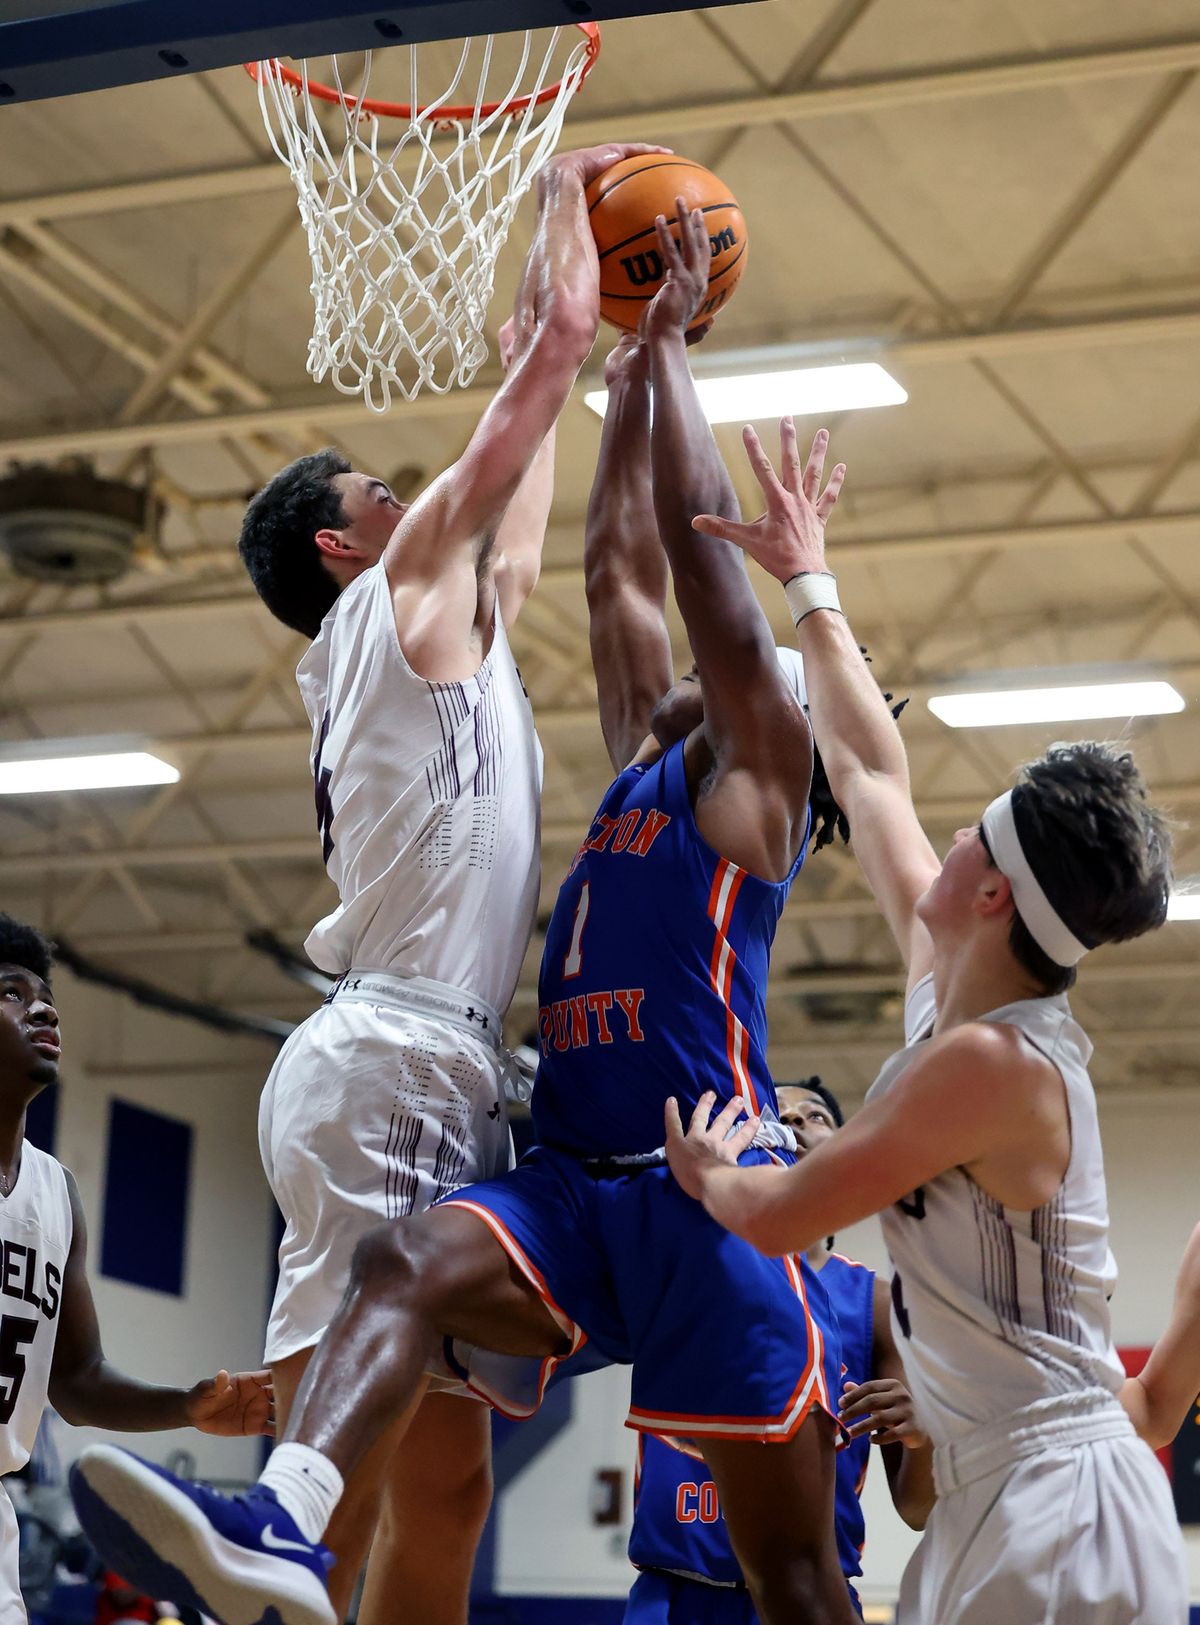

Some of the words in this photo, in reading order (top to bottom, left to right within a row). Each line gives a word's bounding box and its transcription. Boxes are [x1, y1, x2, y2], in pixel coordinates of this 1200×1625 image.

[562, 880, 590, 981] 1
[538, 988, 645, 1058] OUNTY
[0, 1238, 61, 1320] ELS
[675, 1481, 723, 1524] CO
